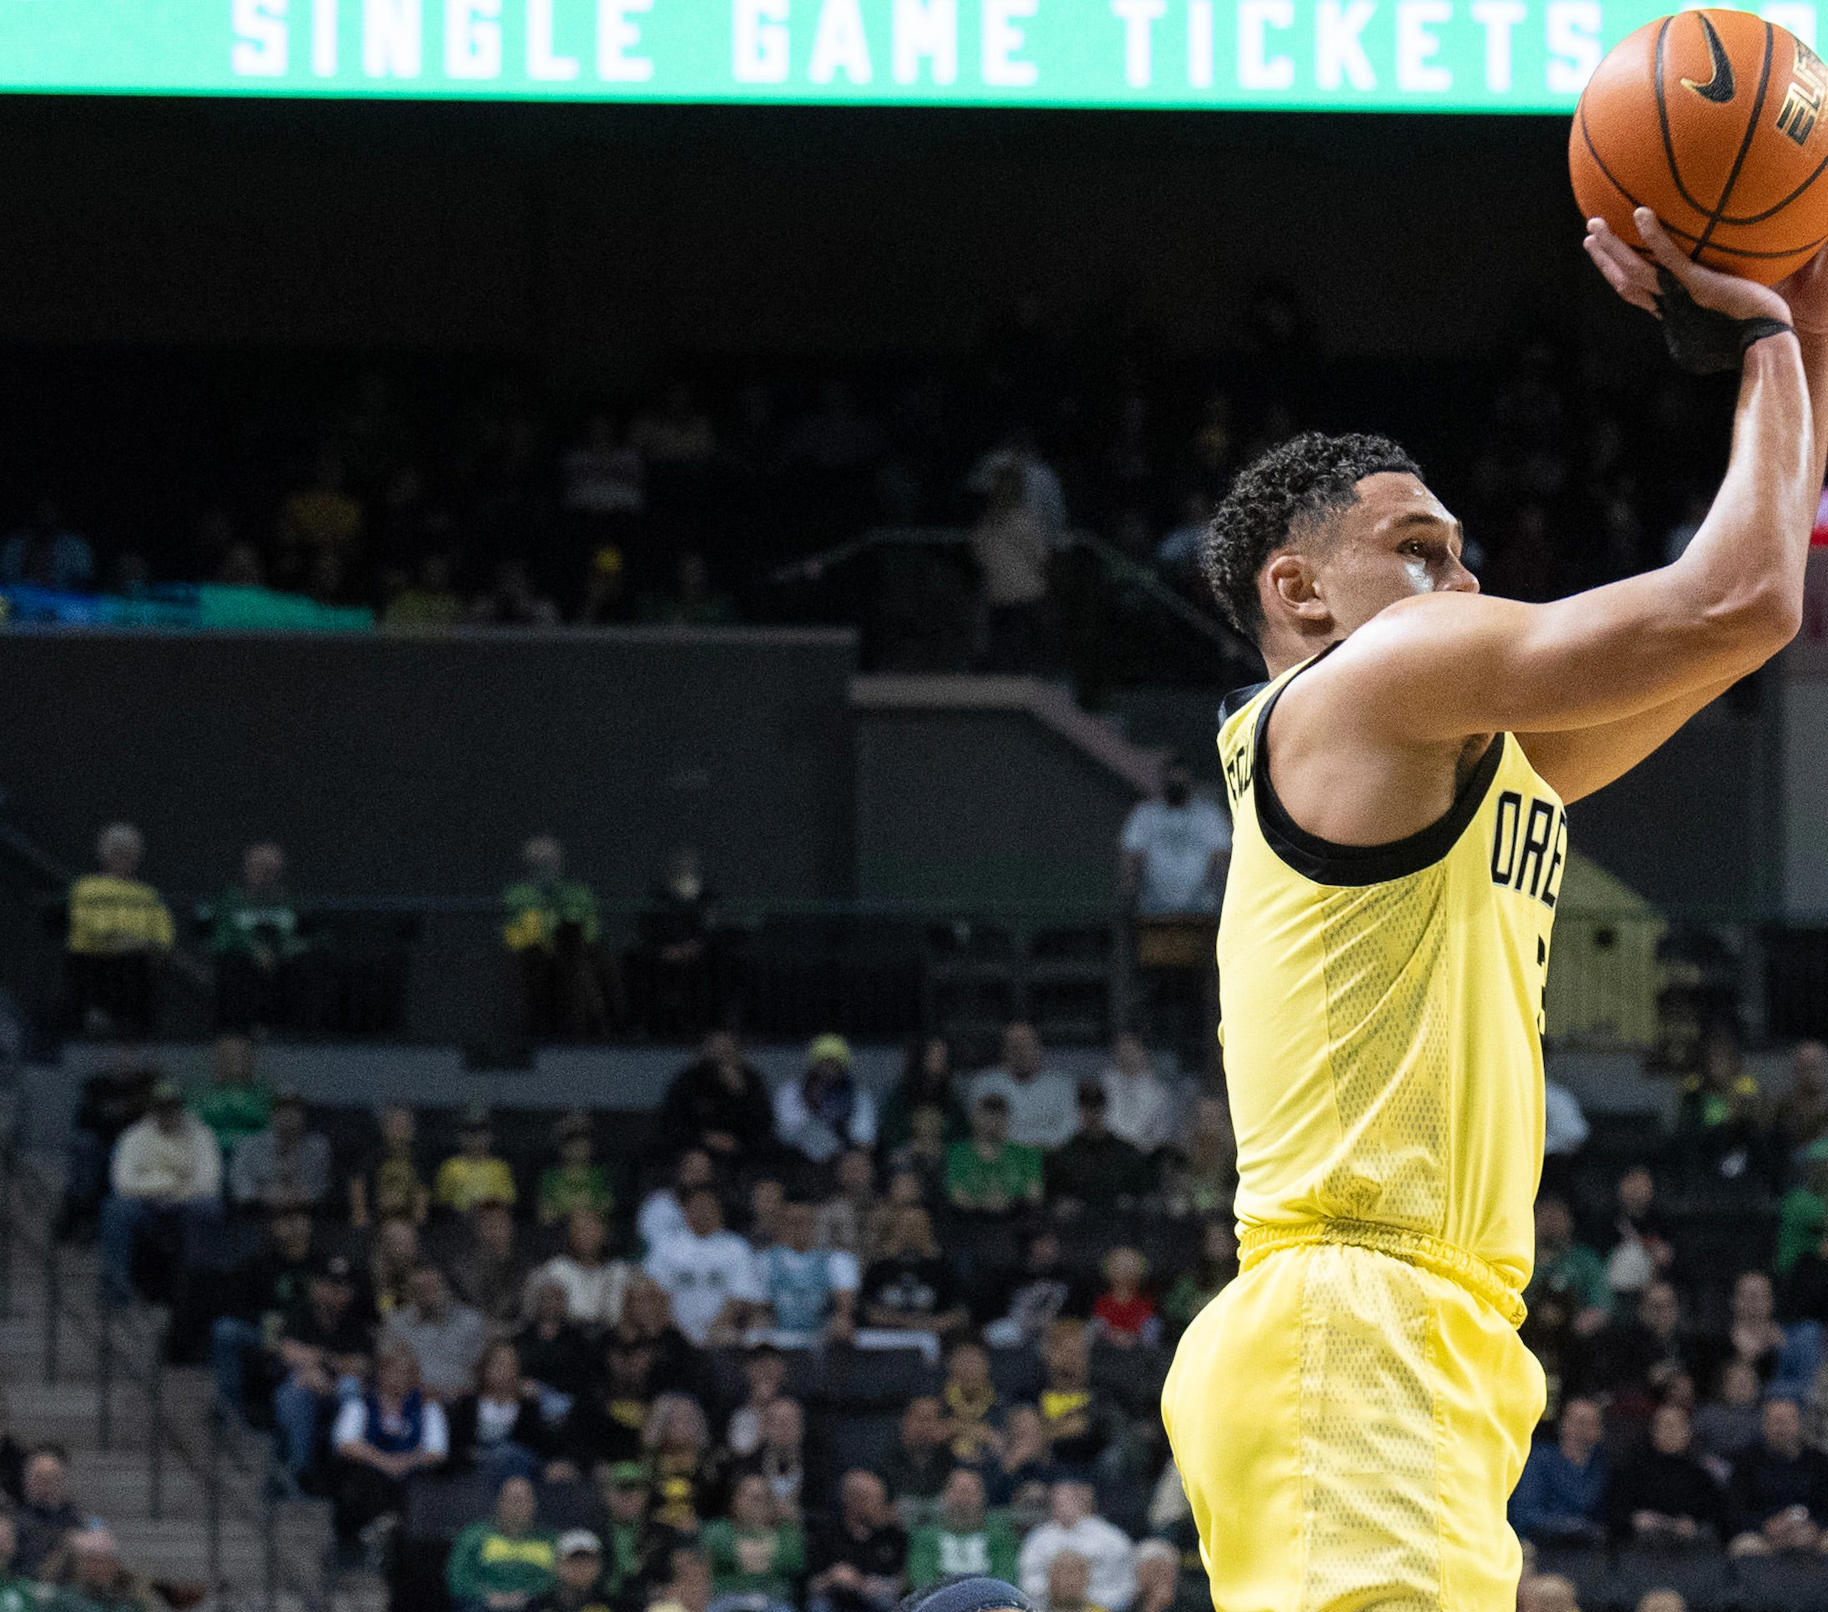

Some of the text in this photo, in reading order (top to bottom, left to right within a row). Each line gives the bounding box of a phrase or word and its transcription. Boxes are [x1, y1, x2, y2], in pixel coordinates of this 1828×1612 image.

[230, 0, 653, 82] SINGLE
[732, 0, 1038, 86] GAME
[1111, 0, 1601, 94] TICKETS
